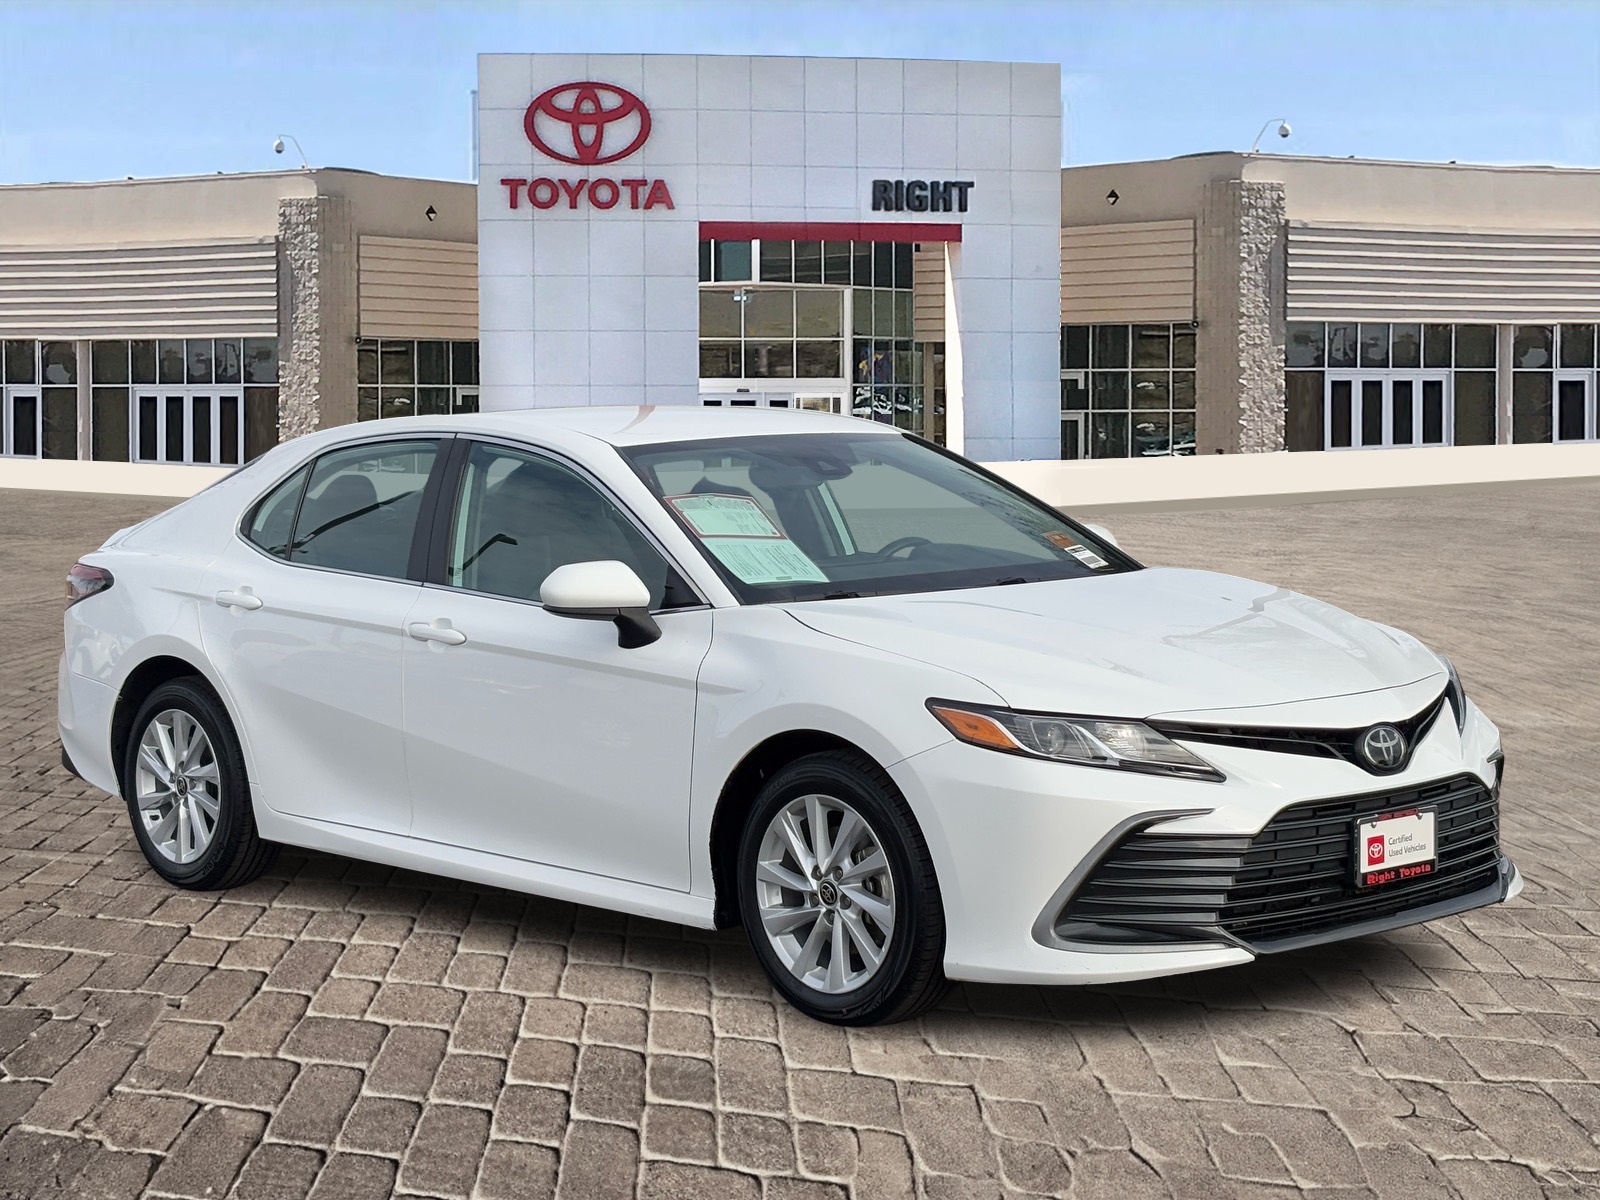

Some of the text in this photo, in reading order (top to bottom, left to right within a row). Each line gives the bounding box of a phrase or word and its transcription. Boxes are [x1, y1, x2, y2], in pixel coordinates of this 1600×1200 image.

[501, 178, 675, 210] TOYOTA
[872, 179, 975, 213] RIGHT
[1388, 833, 1413, 845] Certified
[1388, 843, 1426, 857] Used Vehicles
[1367, 864, 1431, 884] Right Toyota
